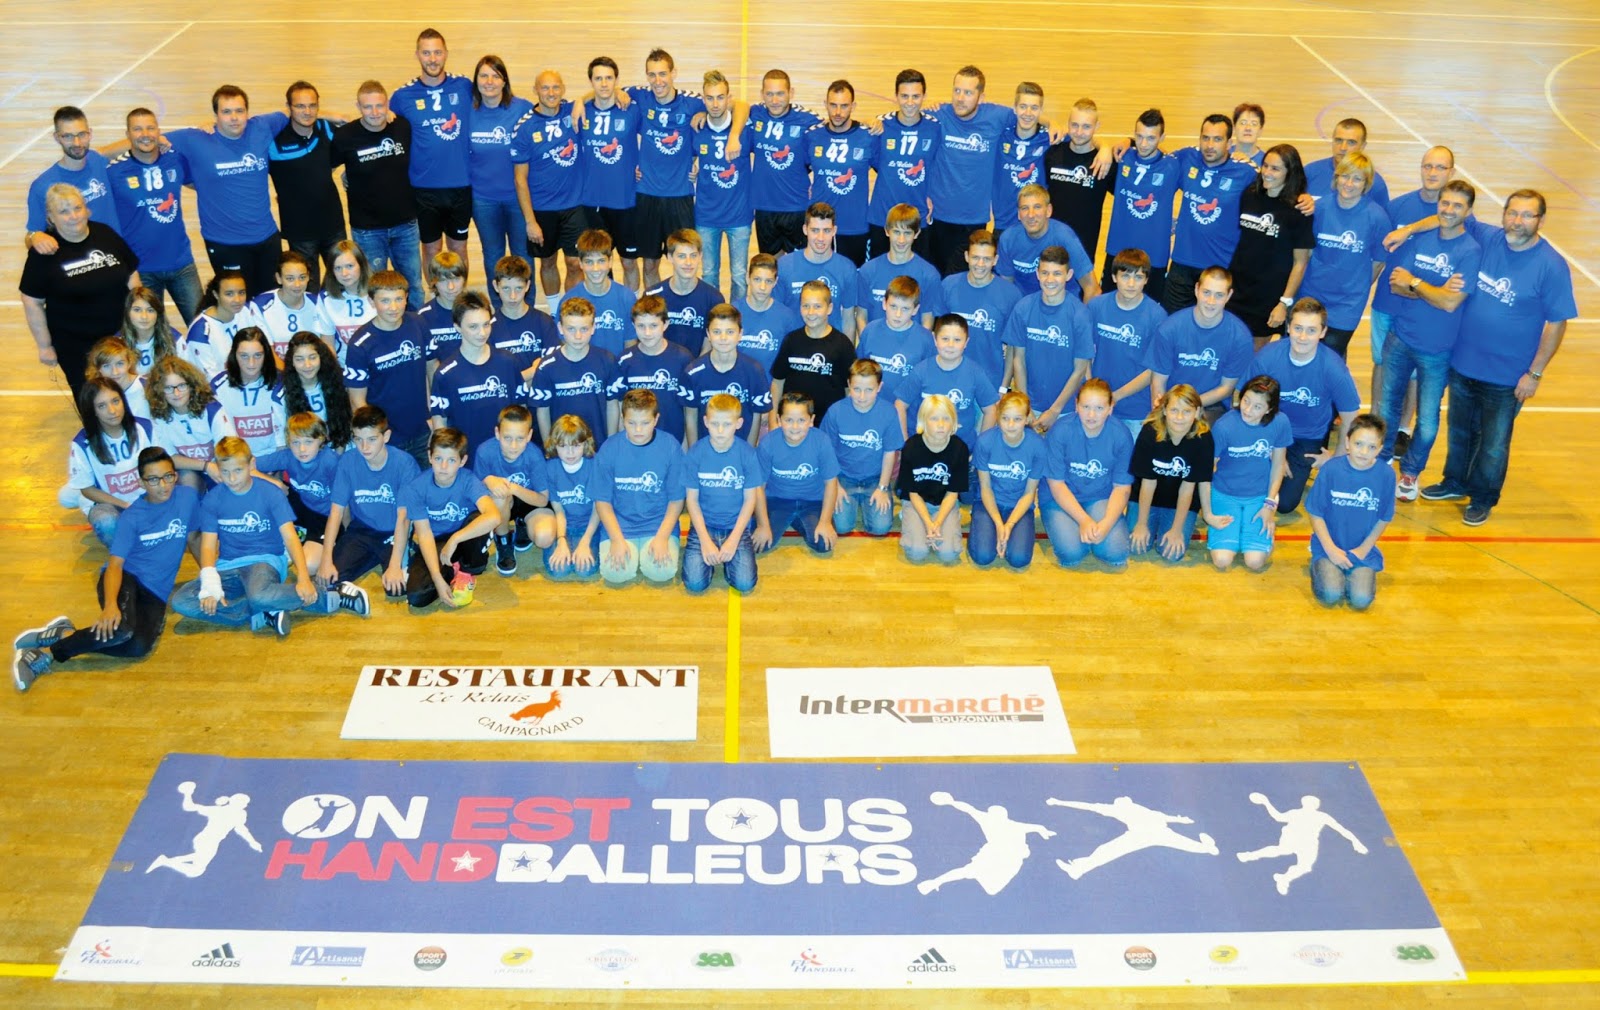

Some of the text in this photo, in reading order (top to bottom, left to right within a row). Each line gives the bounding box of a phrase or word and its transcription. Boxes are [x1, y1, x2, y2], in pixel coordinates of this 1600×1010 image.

[431, 92, 442, 111] 2
[593, 116, 611, 135] 21
[764, 120, 784, 140] 14
[714, 140, 724, 159] 3
[825, 142, 849, 163] 42
[900, 135, 918, 155] 17
[1015, 144, 1026, 161] 9
[144, 168, 164, 191] 18
[1133, 166, 1147, 186] 7
[1200, 170, 1213, 188] 5
[67, 261, 105, 278] HANDBALL
[346, 299, 364, 318] 13
[287, 313, 298, 333] 8
[140, 349, 151, 367] 6
[377, 355, 412, 370] HANDBALL
[241, 387, 260, 407] 17
[460, 391, 497, 402] HANDBALL
[555, 388, 593, 396] HANDBALL
[310, 393, 324, 413] 5
[237, 417, 271, 431] AFAT
[110, 440, 131, 462] 10
[617, 484, 653, 492] HANDBALL
[368, 668, 695, 687] RESTAURANT
[419, 691, 530, 703] Le Relais
[477, 716, 585, 737] CAMPAGNARD
[932, 715, 1019, 723] BOUZONVILLE
[282, 794, 913, 843] ON EST TOUS
[264, 839, 918, 885] HANDBALLEURS
[192, 957, 241, 968] adidas
[907, 963, 957, 973] adidas
